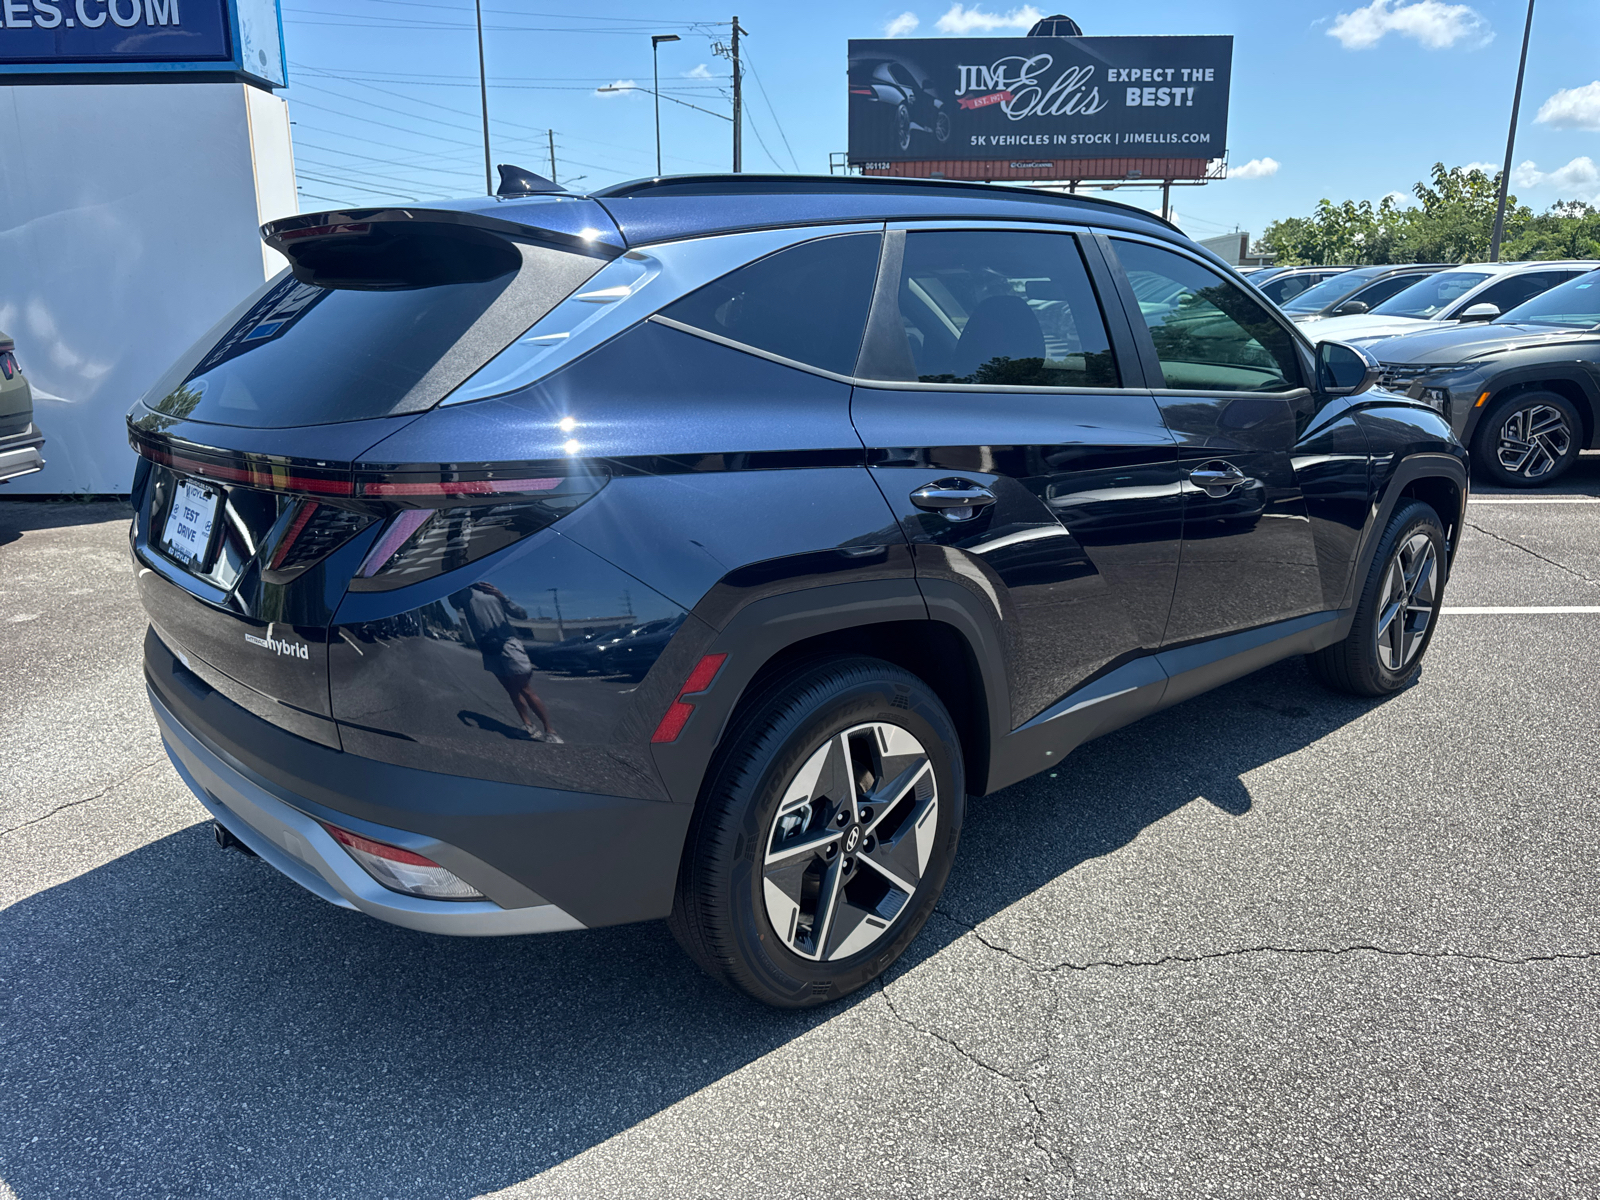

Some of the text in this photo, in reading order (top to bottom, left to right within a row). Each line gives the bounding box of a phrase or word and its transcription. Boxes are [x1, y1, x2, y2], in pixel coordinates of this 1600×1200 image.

[0, 0, 181, 29] ES.COM
[1107, 68, 1215, 82] EXPECT THE
[955, 53, 1109, 121] JIM Ellis
[1125, 87, 1195, 107] BEST!
[974, 97, 989, 107] EST.
[970, 135, 987, 146] 5K
[990, 134, 1050, 146] VEHICLES
[1053, 134, 1067, 145] IN
[1070, 133, 1112, 145] STOCK
[1123, 133, 1211, 144] JIMELLIS.COM
[183, 506, 200, 524] TEST
[177, 522, 197, 543] DRIVE
[267, 638, 309, 660] hybrid
